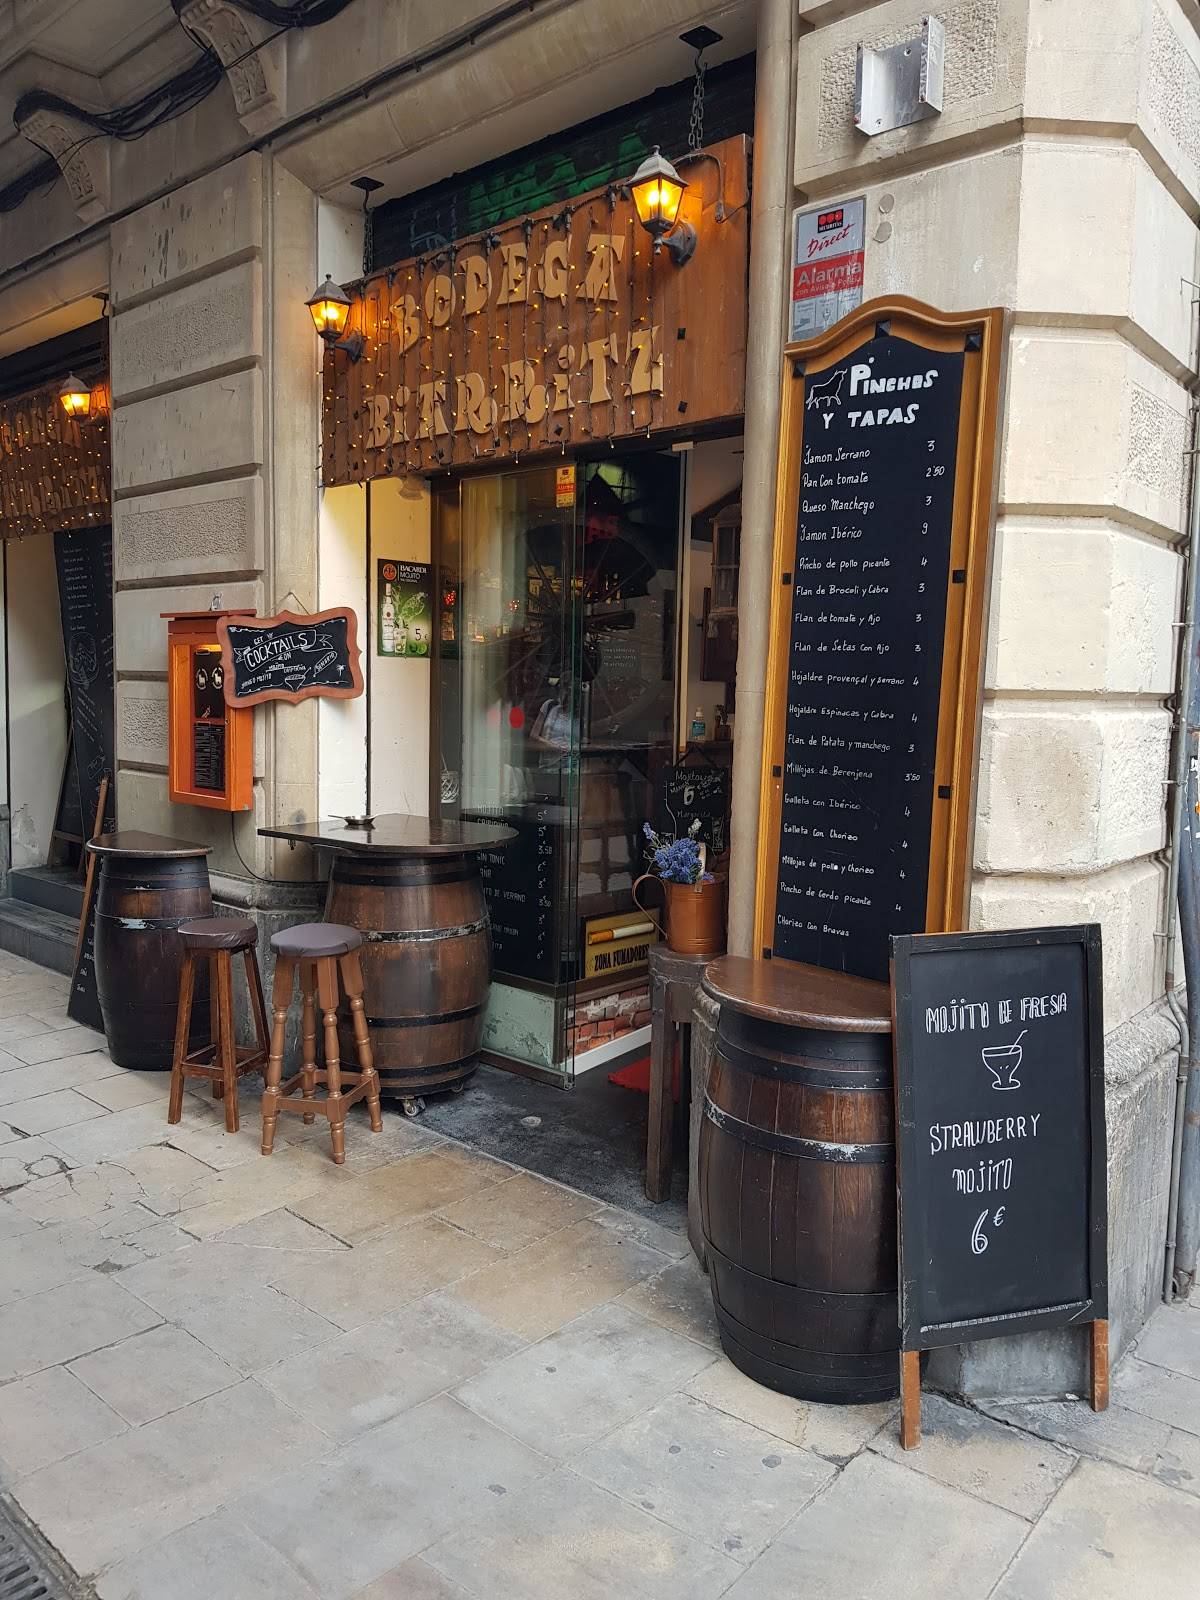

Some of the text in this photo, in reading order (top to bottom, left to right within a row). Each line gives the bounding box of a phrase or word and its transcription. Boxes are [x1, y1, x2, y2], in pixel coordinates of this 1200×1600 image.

[797, 262, 862, 288] Alarma
[390, 233, 626, 356] BODEGA
[823, 404, 919, 429] Y TAPAS
[835, 447, 870, 462] Serrano
[927, 440, 935, 451] 3
[802, 472, 818, 488] Pan
[837, 472, 869, 484] tomate
[802, 496, 932, 514] Queso Manchego 3
[831, 526, 862, 539] Ibérico
[400, 565, 426, 573] BACARDI
[800, 557, 927, 572] Pincho de pollo picante 4
[796, 586, 812, 596] Flan
[816, 585, 825, 594] de
[829, 584, 859, 594] Brocoli
[862, 588, 866, 597] y
[918, 583, 925, 592] 3
[795, 612, 921, 626] Flan de tomate y Ajo 3
[247, 633, 308, 668] COCKTAILS
[794, 642, 810, 651] Flan
[817, 643, 827, 651] de
[832, 640, 856, 651] Setas
[876, 644, 889, 654] Ajo
[792, 670, 823, 684] Hojaldre
[871, 679, 875, 687] y
[913, 677, 919, 686] 4
[821, 708, 859, 718] Espinacas
[864, 712, 868, 721] y
[912, 714, 917, 723] 4
[788, 734, 914, 752] Flan de Patata y manchego 3
[819, 766, 827, 774] de
[829, 798, 860, 810] Ibérico
[905, 807, 910, 817] 4
[809, 859, 816, 867] de
[841, 866, 845, 874] y
[900, 870, 906, 879] 4
[781, 882, 801, 893] Pincho
[806, 887, 815, 896] de
[823, 925, 849, 936] Bravas
[594, 952, 611, 971] ZONA
[1020, 992, 1067, 1022] FRESA
[930, 1114, 1040, 1155] STRAWBERRY
